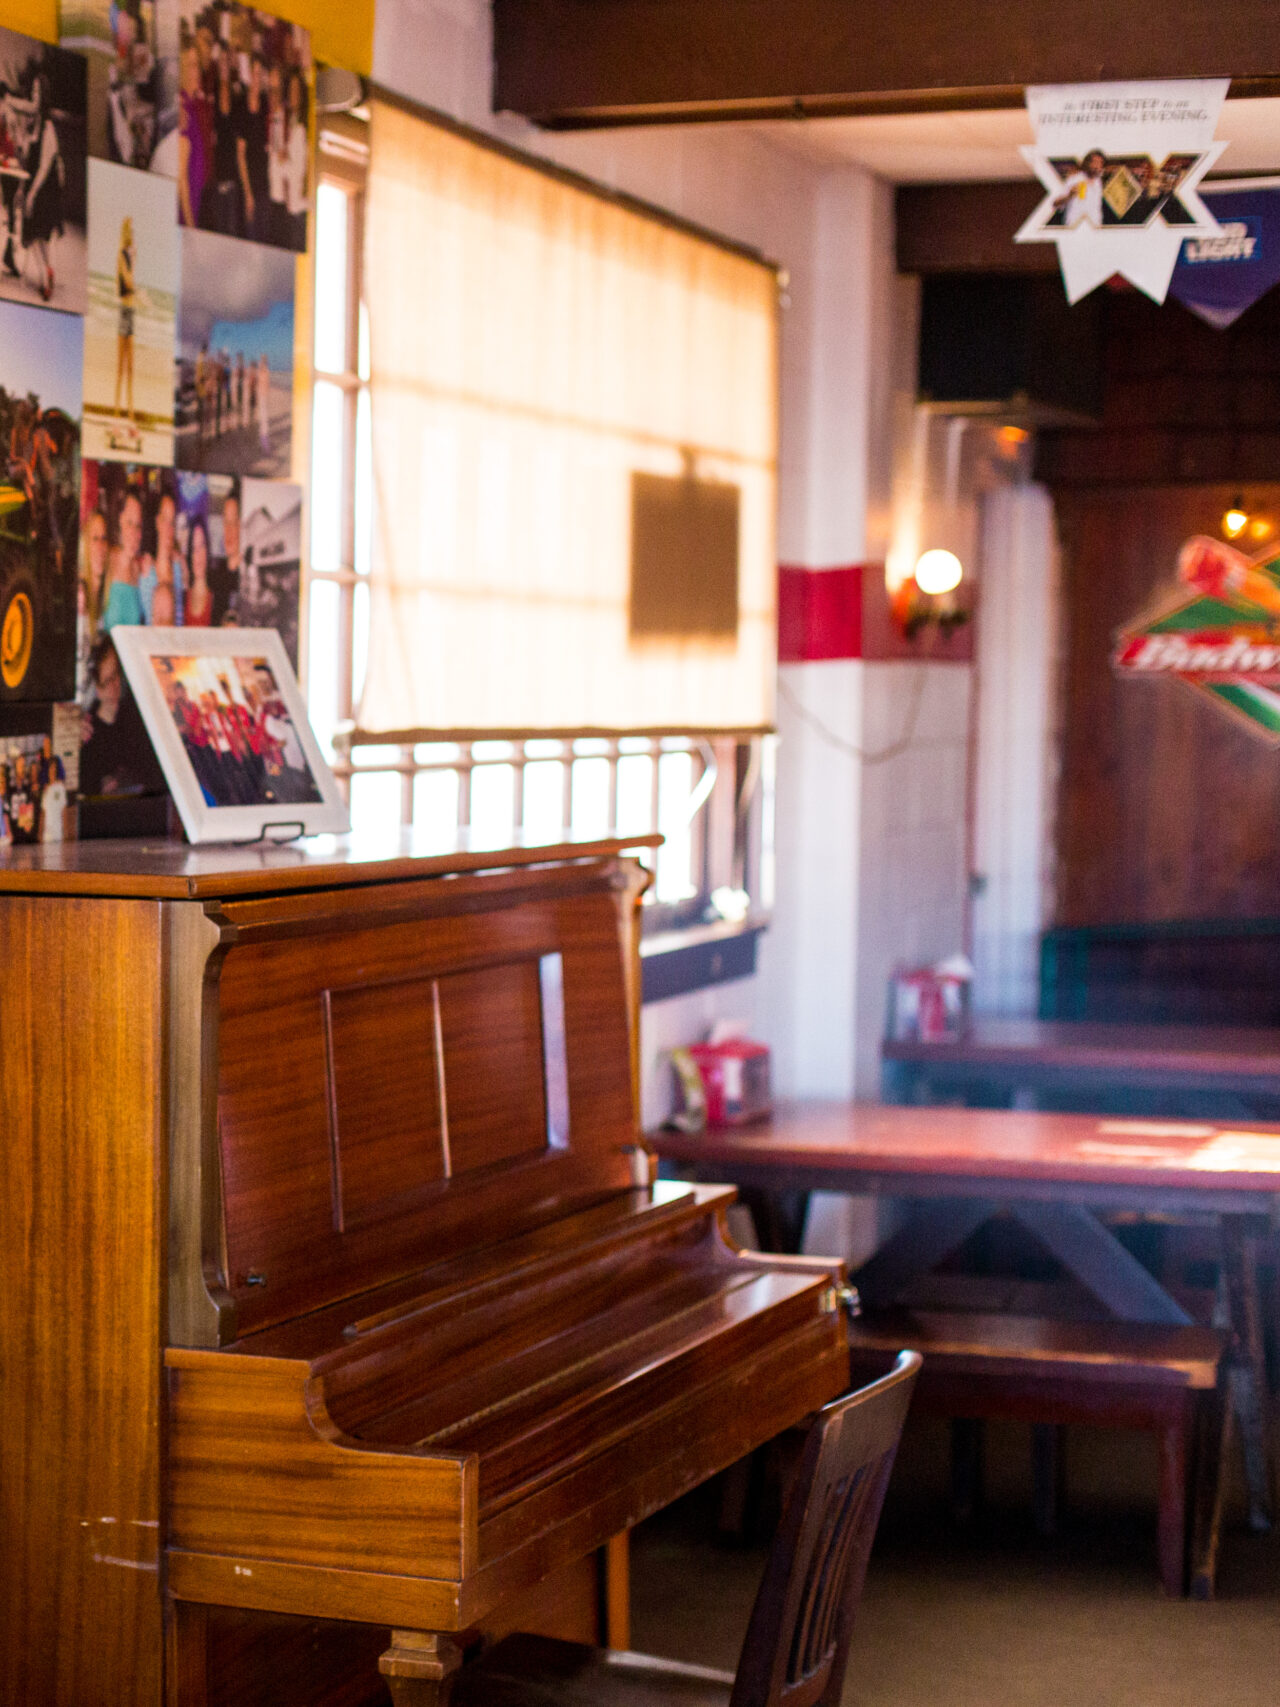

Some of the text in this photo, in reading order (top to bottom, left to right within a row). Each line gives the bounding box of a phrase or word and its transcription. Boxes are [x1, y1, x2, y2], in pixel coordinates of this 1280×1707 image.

[1080, 99, 1120, 112] FIRST
[1124, 98, 1160, 110] STEP
[1039, 111, 1137, 125] INTERESTING
